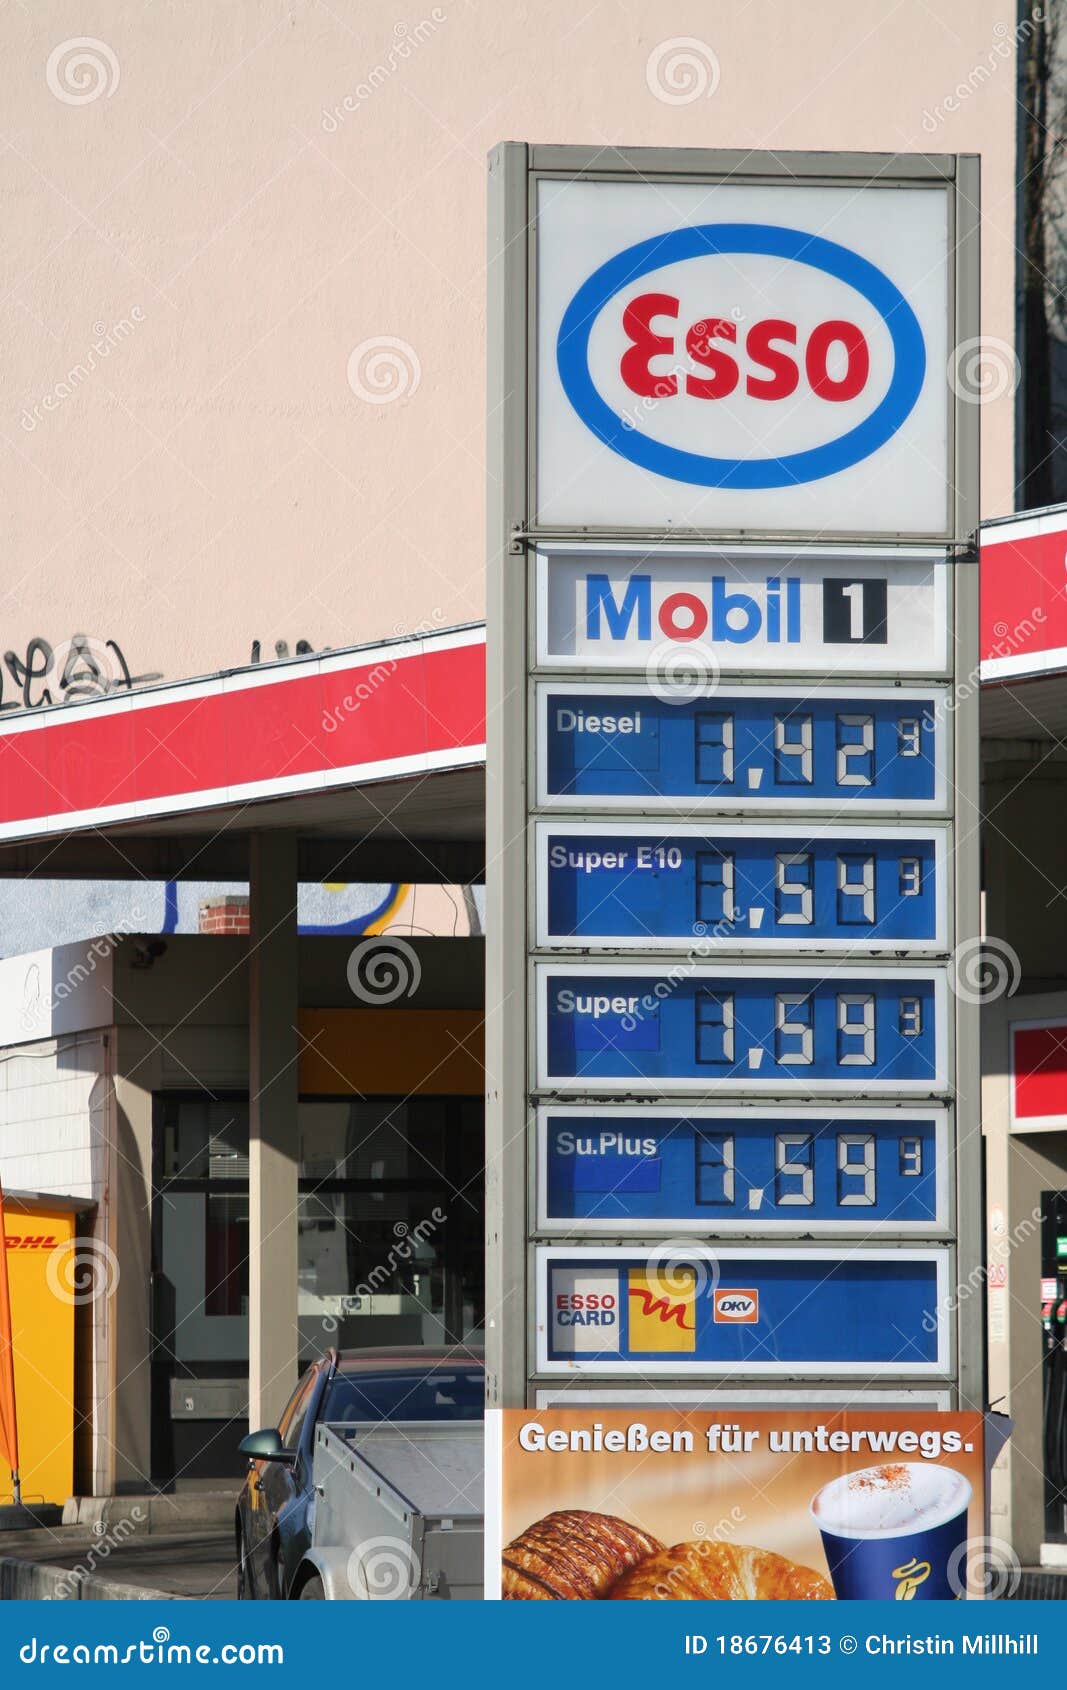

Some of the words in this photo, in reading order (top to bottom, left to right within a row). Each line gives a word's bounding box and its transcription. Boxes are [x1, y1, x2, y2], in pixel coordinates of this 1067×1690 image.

[620, 293, 870, 402] Esso
[586, 574, 801, 643] Mobil
[842, 583, 865, 639] 1
[556, 709, 641, 734] Diesel
[550, 846, 628, 873] Super
[637, 847, 682, 869] E10
[556, 990, 639, 1015] Super
[556, 1132, 657, 1156] Su.Plus
[556, 1294, 616, 1310] ESSO
[720, 1301, 753, 1312] DKV
[557, 1310, 616, 1326] CARD
[519, 1422, 694, 1453] Genießen
[707, 1423, 760, 1453] für
[770, 1427, 974, 1459] unterwegs.
